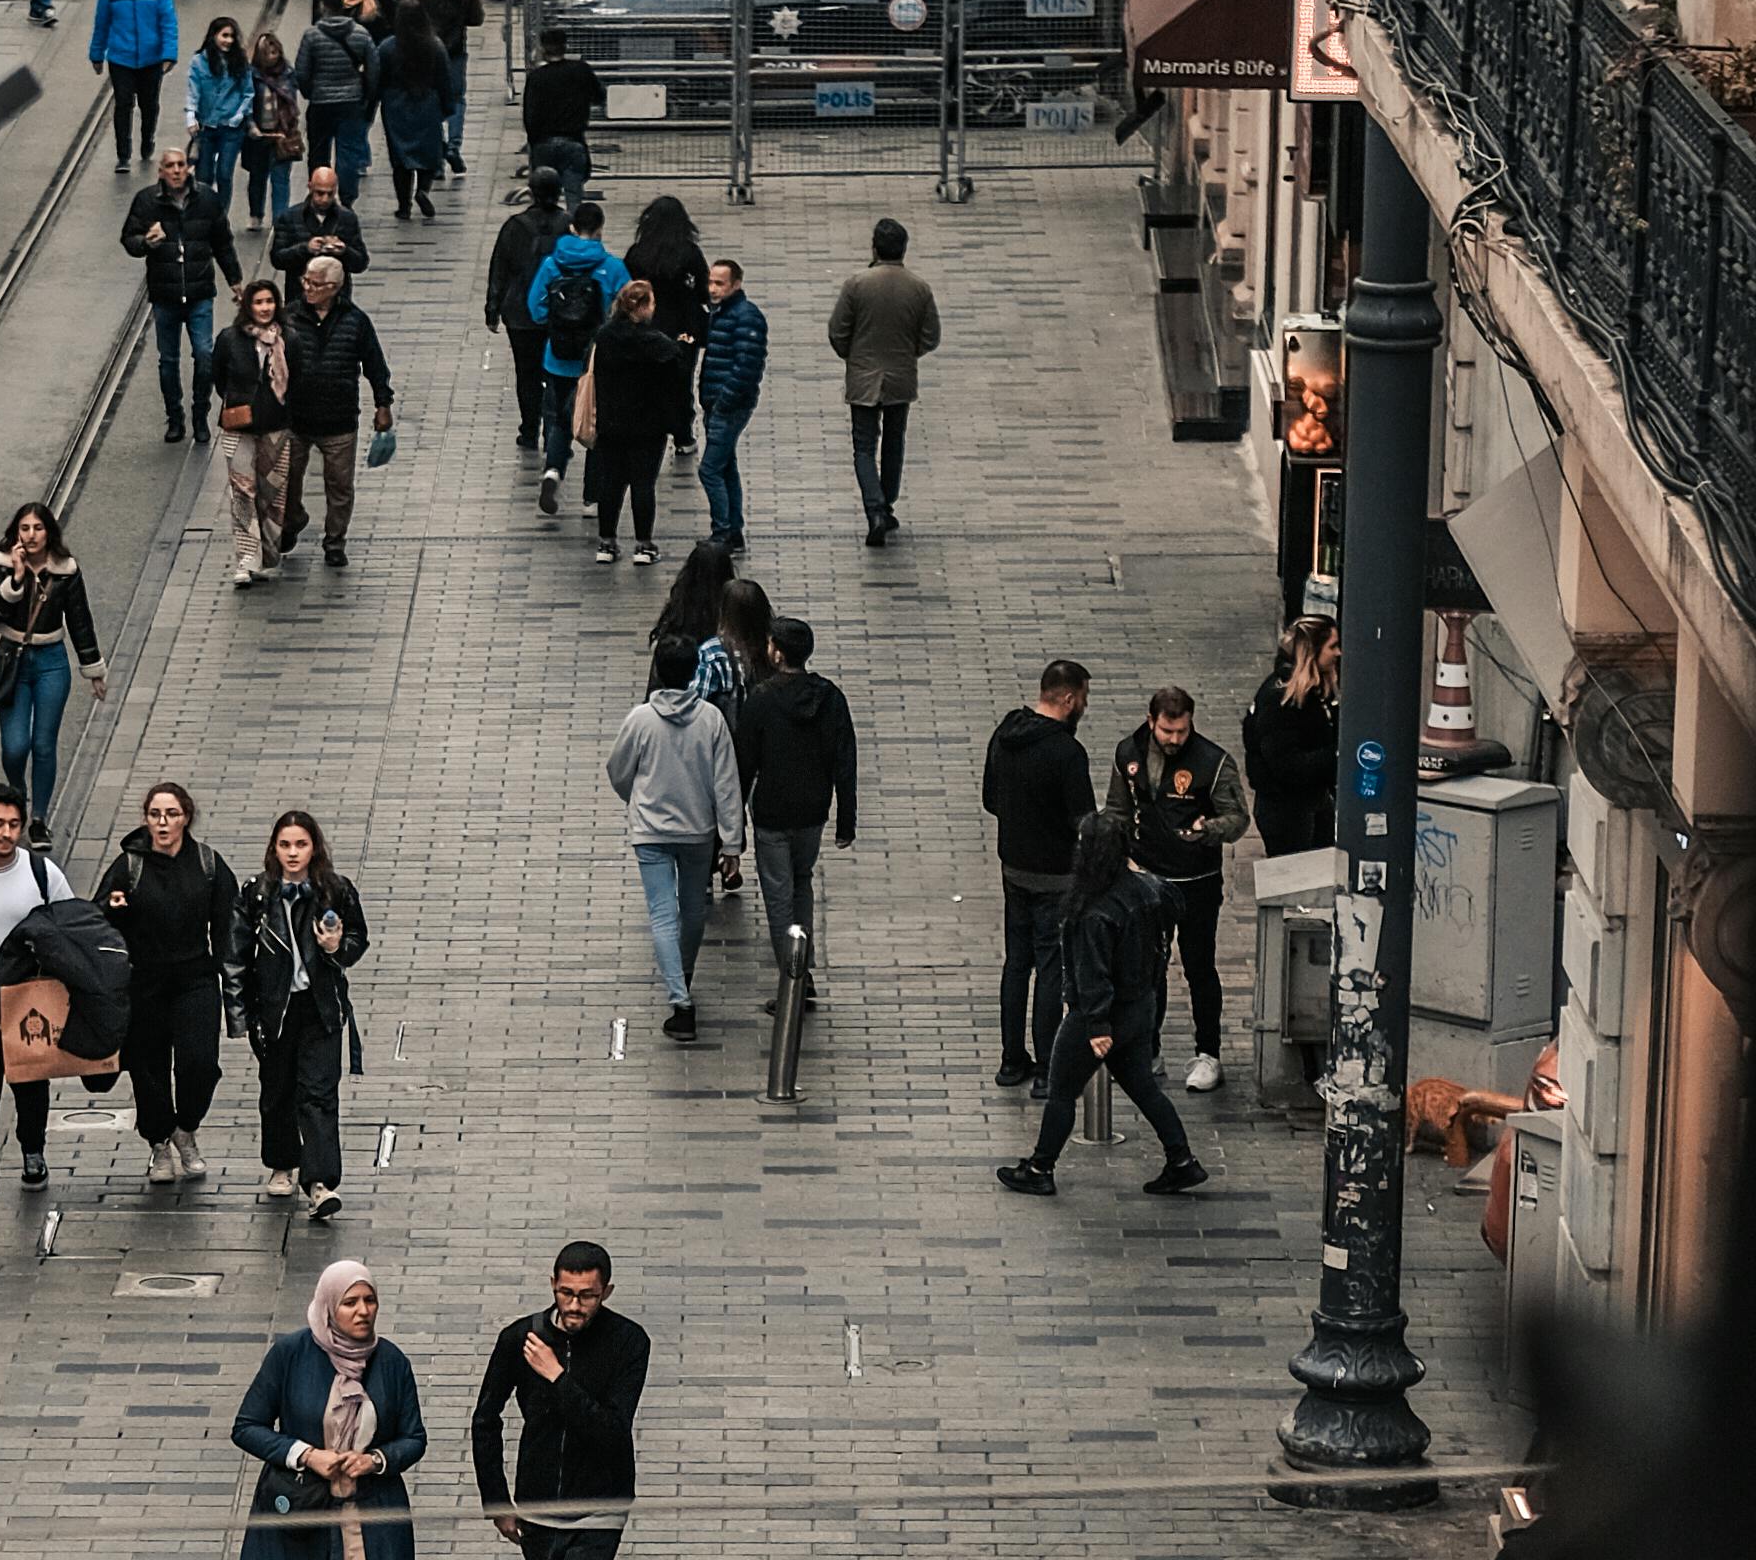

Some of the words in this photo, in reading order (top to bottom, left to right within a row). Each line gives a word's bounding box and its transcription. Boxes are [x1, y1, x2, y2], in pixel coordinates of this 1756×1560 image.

[1144, 59, 1230, 76] Marmaris
[1234, 59, 1276, 77] Büfe
[817, 88, 873, 109] POLİS
